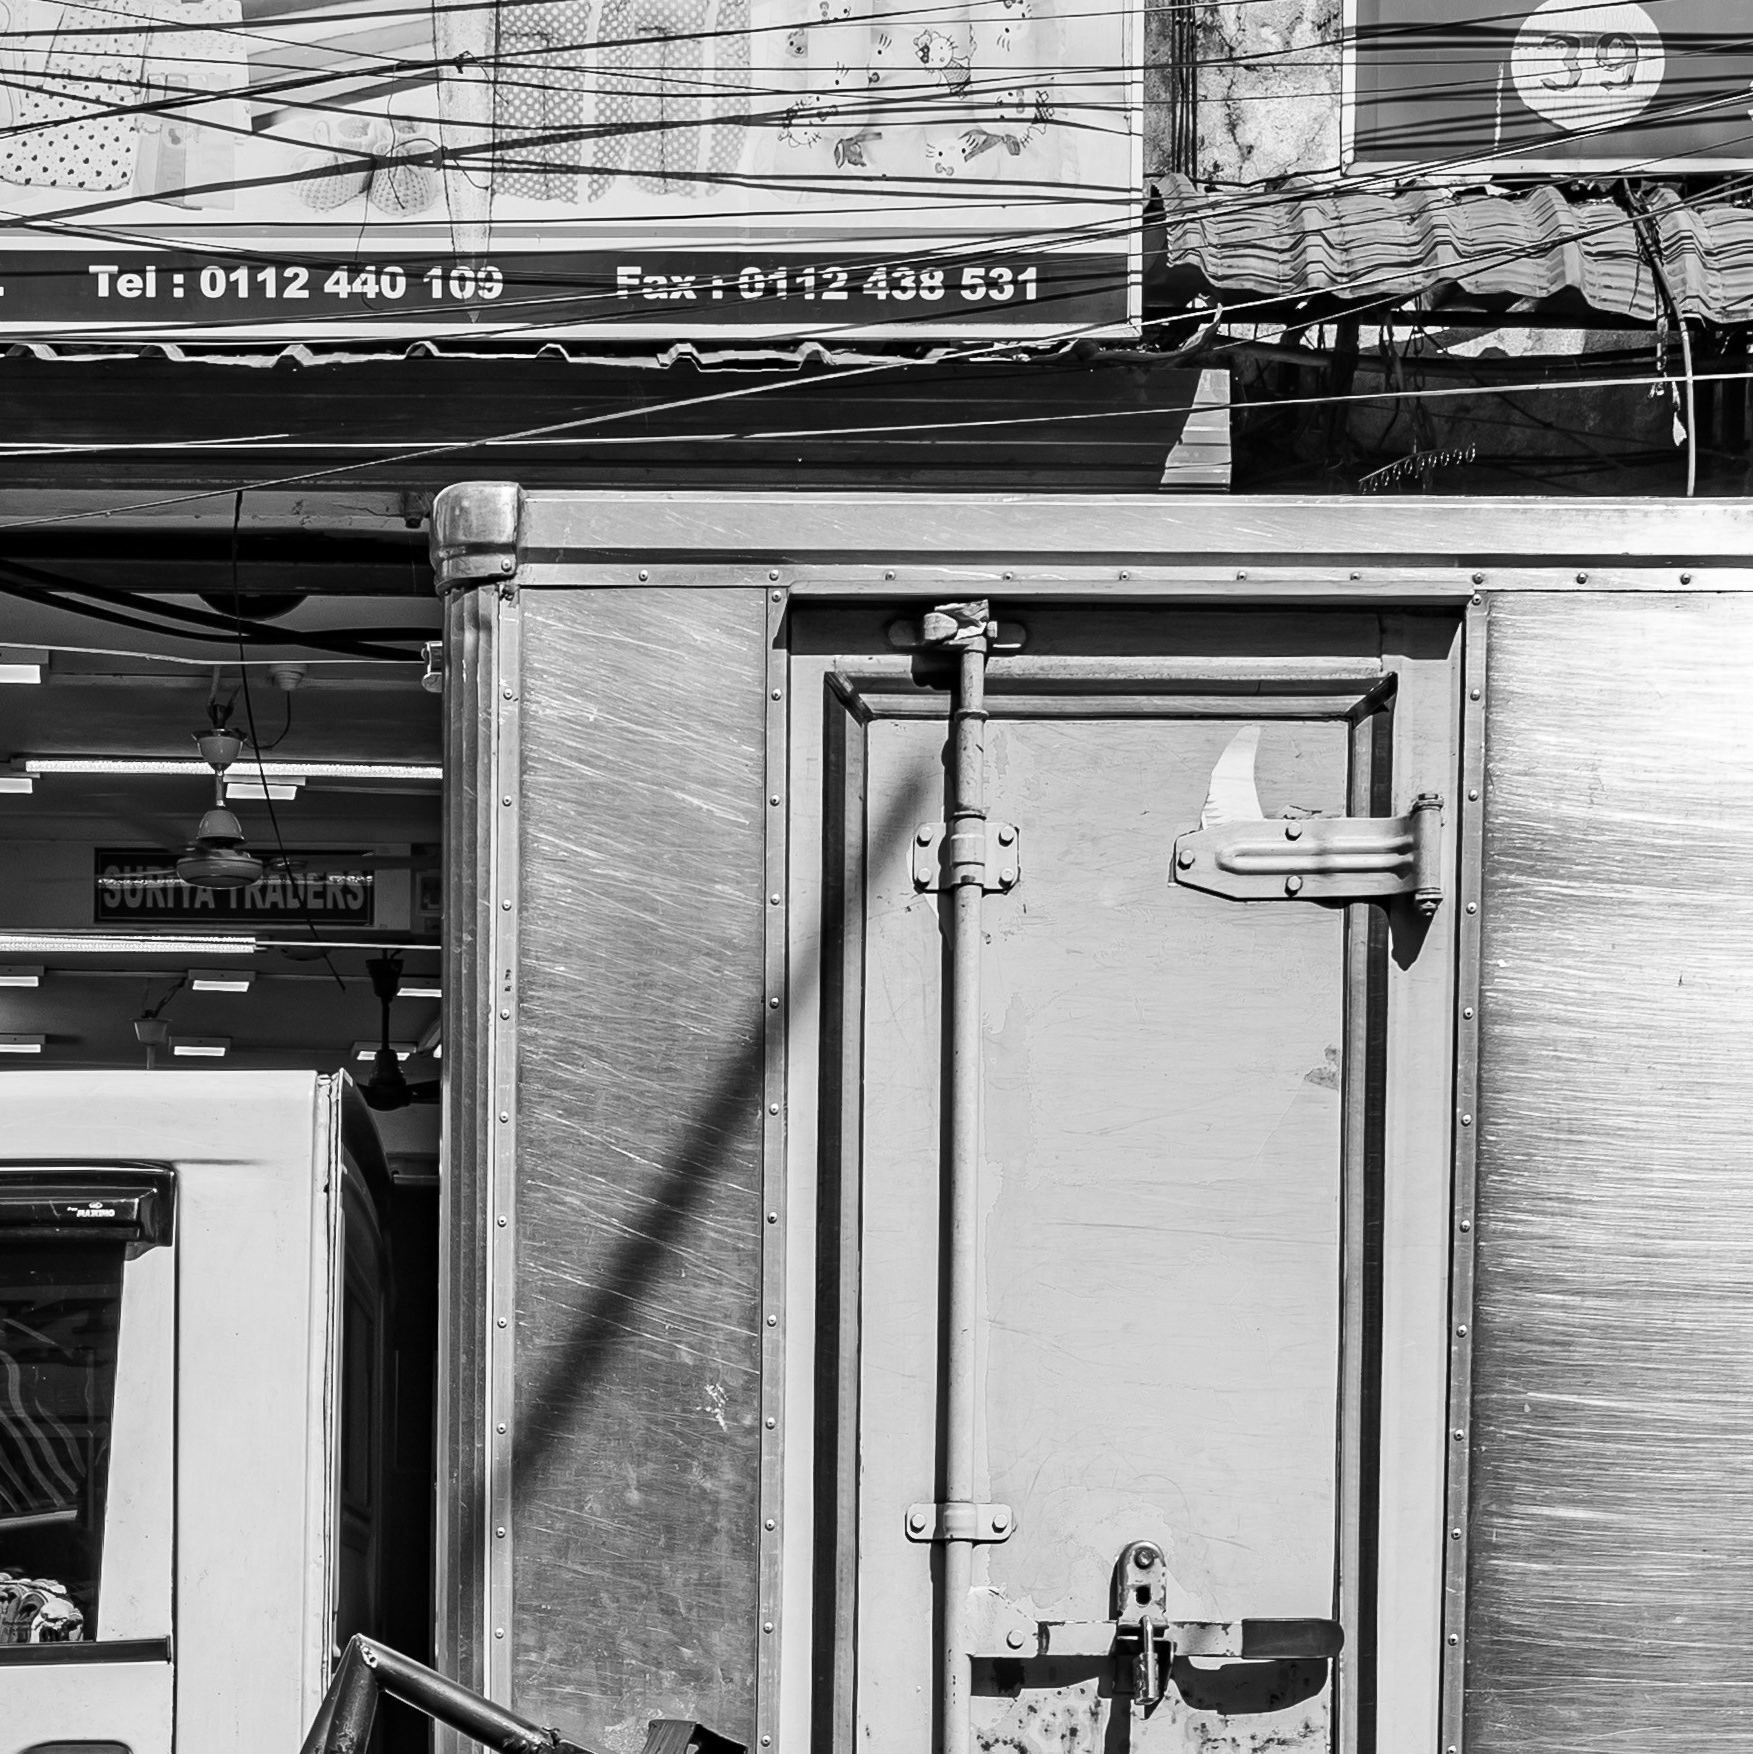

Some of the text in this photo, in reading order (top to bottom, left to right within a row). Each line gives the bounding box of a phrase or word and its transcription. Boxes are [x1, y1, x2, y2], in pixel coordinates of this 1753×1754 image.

[1540, 31, 1638, 93] 39
[89, 266, 156, 299] Tel
[199, 266, 310, 300] 0112
[324, 267, 406, 300] 440
[616, 266, 698, 301] Fax
[739, 266, 849, 301] 0112
[862, 267, 946, 302] 438
[960, 267, 1039, 301] 531
